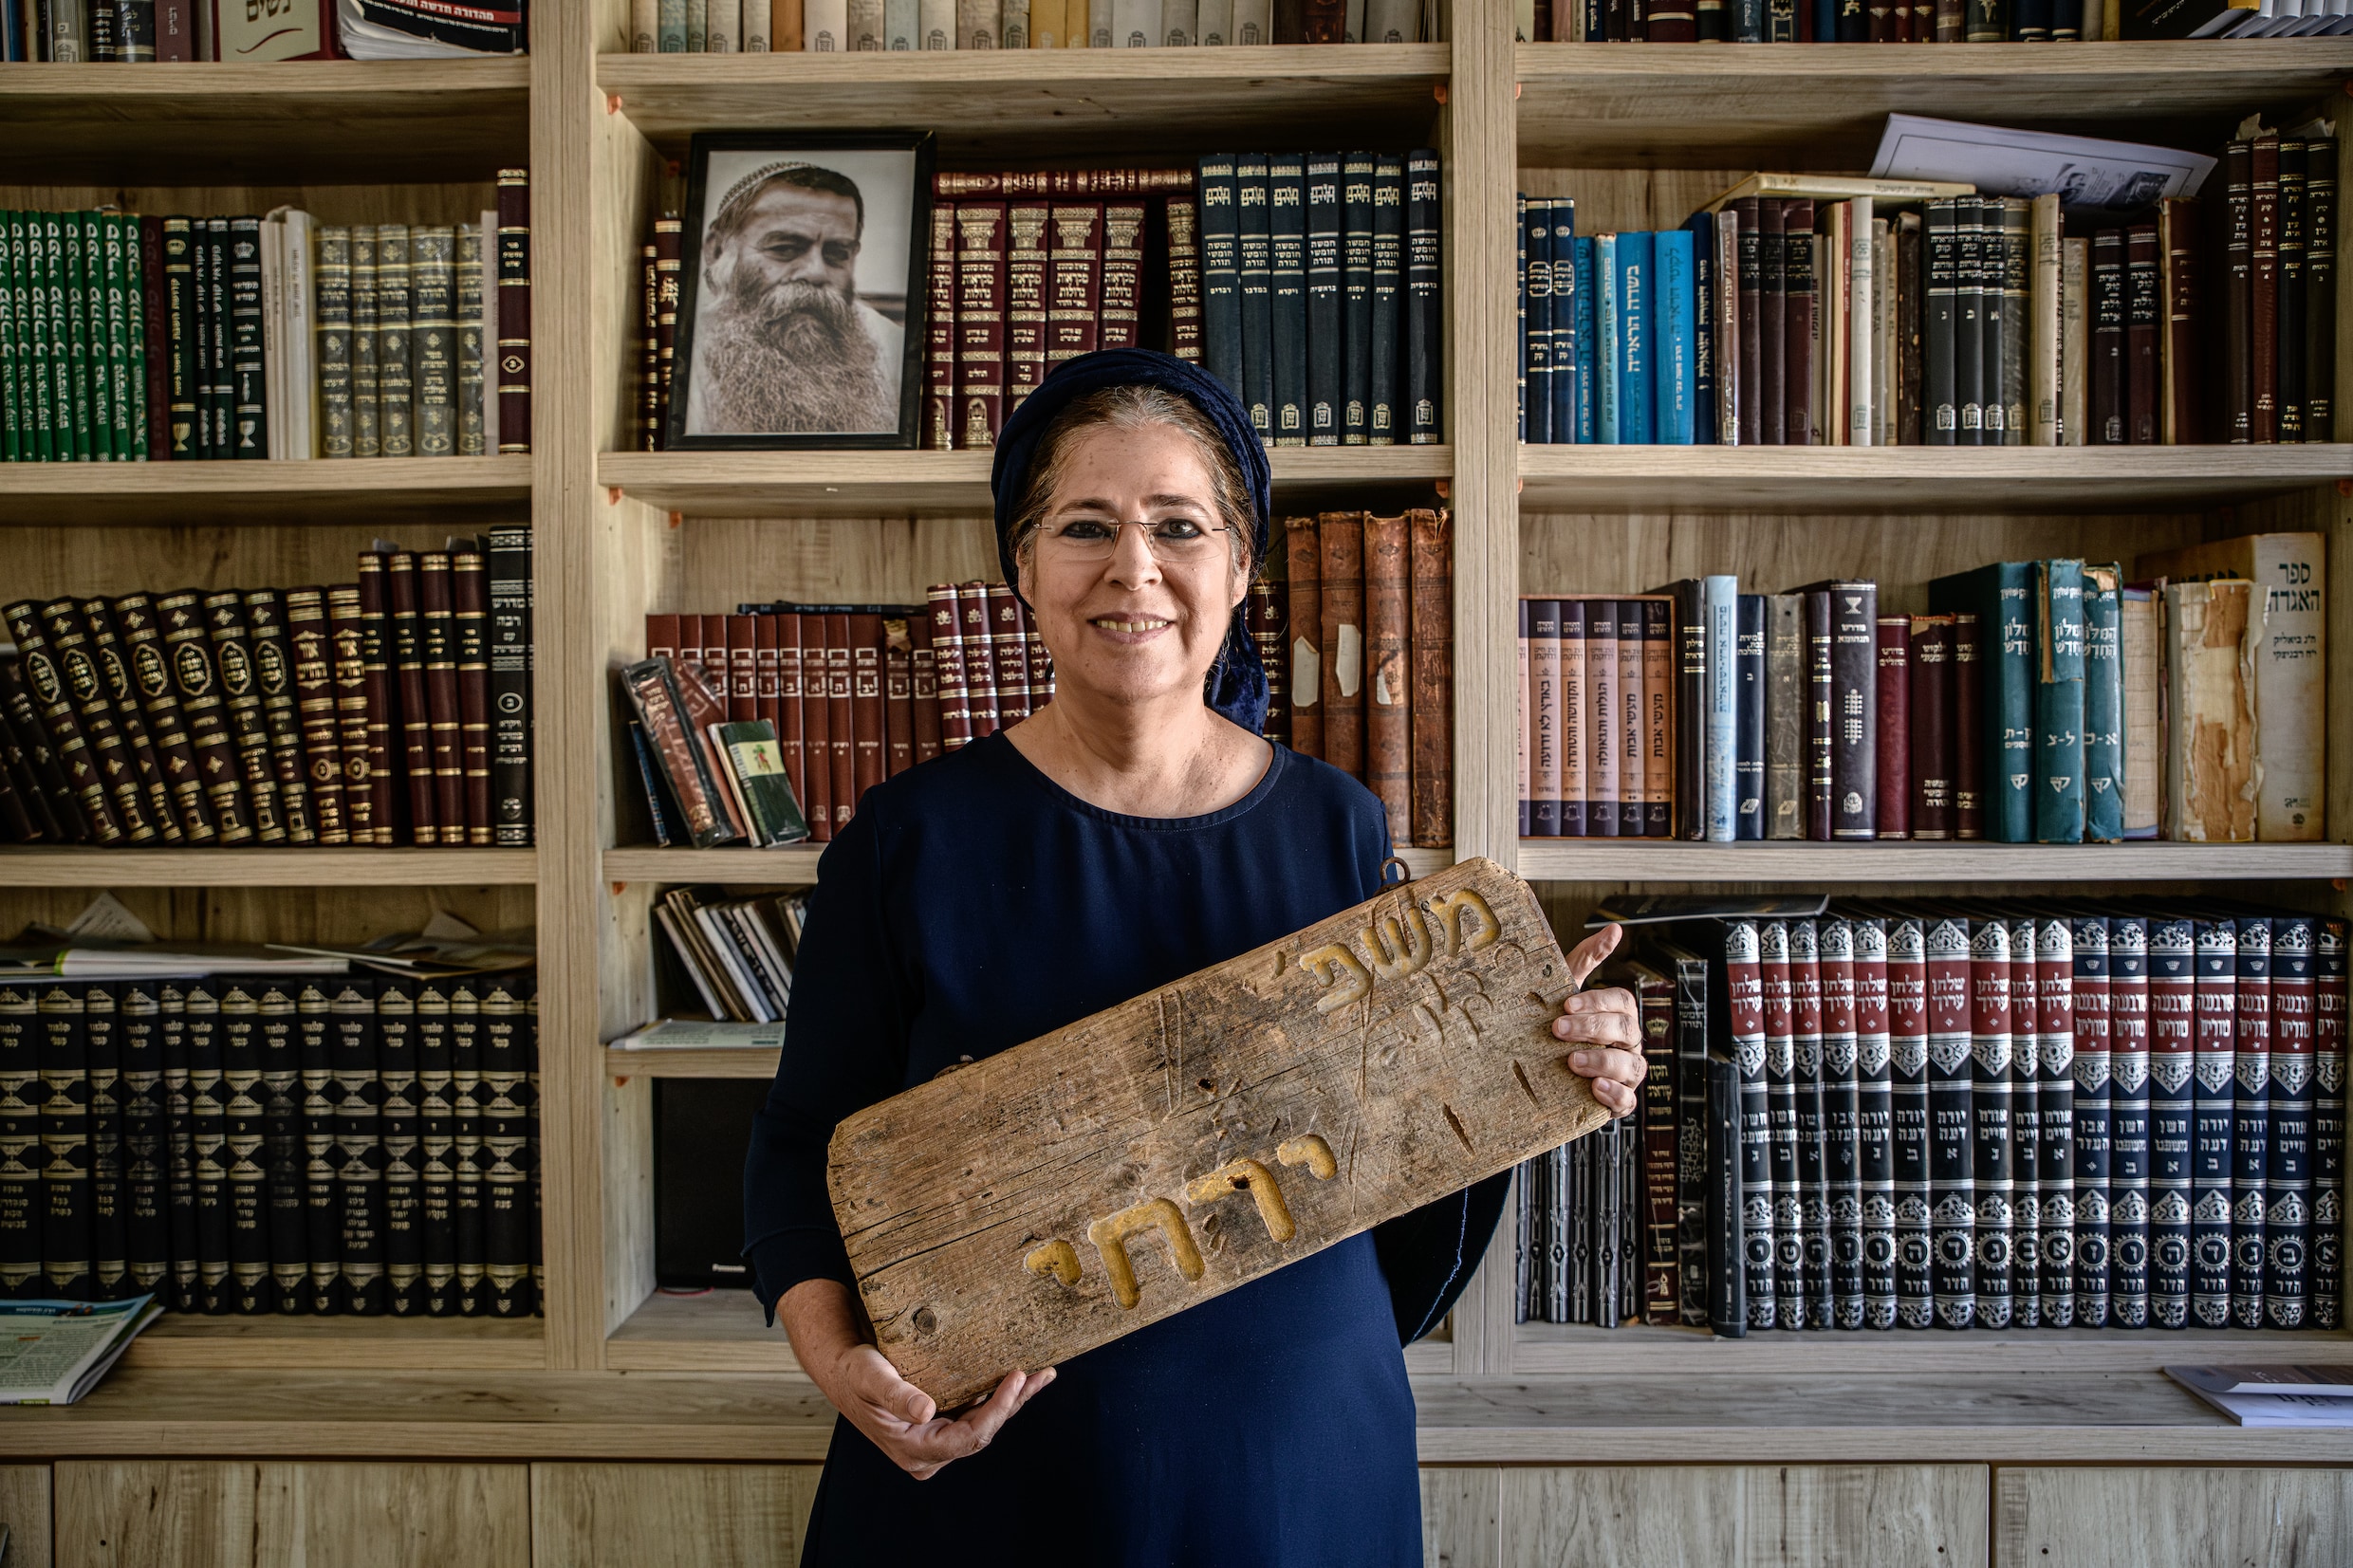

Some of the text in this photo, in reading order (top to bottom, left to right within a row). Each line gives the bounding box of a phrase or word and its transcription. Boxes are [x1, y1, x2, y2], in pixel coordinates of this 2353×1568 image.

[422, 1, 494, 21] מהדורה חדשה
[11, 222, 25, 278] ספרי
[28, 222, 44, 279] ספרי
[46, 222, 61, 278] ספרי
[66, 222, 80, 278] ספרי
[86, 222, 100, 278] ספרי
[1207, 242, 1232, 250] חמשה
[1242, 242, 1268, 250] חמשה
[1275, 242, 1301, 250] חמשה
[1375, 242, 1399, 250] חמשה
[1411, 246, 1436, 254] חומשי
[1412, 237, 1436, 246] חמשה
[106, 224, 121, 279] ספרי
[127, 225, 140, 281] ספרי
[1207, 250, 1232, 259] חומשי
[1242, 250, 1269, 259] חומשי
[1274, 250, 1302, 259] חומשי
[1310, 248, 1337, 256] חומשי
[1312, 256, 1334, 266] תורה
[1345, 248, 1371, 256] חומשי
[1347, 256, 1368, 265] תורה
[1374, 250, 1399, 259] חומשי
[1414, 254, 1435, 263] תורה
[1245, 258, 1266, 267] תורה
[1277, 259, 1298, 267] תורה
[1376, 258, 1397, 267] תורה
[1665, 248, 1684, 283] לקוטי
[1210, 286, 1232, 295] דברים
[1310, 285, 1337, 293] בראשית
[1410, 282, 1437, 290] בראשית
[1725, 277, 1734, 323] שבת הארץ
[1626, 265, 1641, 372] בשדה הראי"ה
[1695, 259, 1711, 378] מתוך התורה הגואלת
[2279, 563, 2311, 584] ספר
[2270, 589, 2320, 613] האגדה
[1841, 623, 1866, 632] מדרש
[1837, 634, 1870, 643] תנחומא
[2273, 633, 2302, 645] ביאליק
[1881, 647, 1905, 655] מדרש
[2272, 651, 2303, 662] רבניצקי
[1538, 680, 1552, 767] בארץ לא זרועה
[1566, 680, 1580, 767] הקדושה והטהרה
[1596, 682, 1608, 766] הגלות והגאולה
[1625, 693, 1638, 758] מעשי אבות
[1652, 693, 1664, 758] מעשי אבות
[2047, 730, 2075, 747] ל-צ
[1731, 973, 1762, 996] שלחן
[1824, 971, 1854, 995] שלחן
[1856, 971, 1887, 996] שלחן
[1891, 973, 1924, 996] שלחן
[1932, 971, 1965, 994] שלחן
[1976, 971, 2010, 995] שלחן
[2041, 971, 2072, 995] שלחן
[1732, 995, 1763, 1015] ערוך
[1824, 995, 1854, 1013] ערוך
[1856, 994, 1886, 1013] ערוך
[1891, 995, 1924, 1015] ערוך
[1932, 993, 1965, 1013] ערוך
[1976, 994, 2009, 1013] ערוך
[2040, 994, 2072, 1012] ערוך
[2111, 993, 2148, 1012] ארבעה
[2153, 994, 2192, 1013] ארבעה
[2196, 993, 2234, 1012] ארבעה
[2276, 994, 2314, 1013] ארבעה
[2076, 1017, 2108, 1038] טורים
[2115, 1017, 2146, 1038] טורים
[2157, 1018, 2189, 1038] טורים
[2200, 1018, 2231, 1038] טורים
[2279, 1018, 2311, 1039] טורים
[1937, 1110, 1966, 1124] יורה
[2200, 1118, 2228, 1132] יורה
[1939, 1127, 1967, 1140] דעה
[2200, 1138, 2227, 1152] דעה
[1024, 1134, 1338, 1310] ירחי
